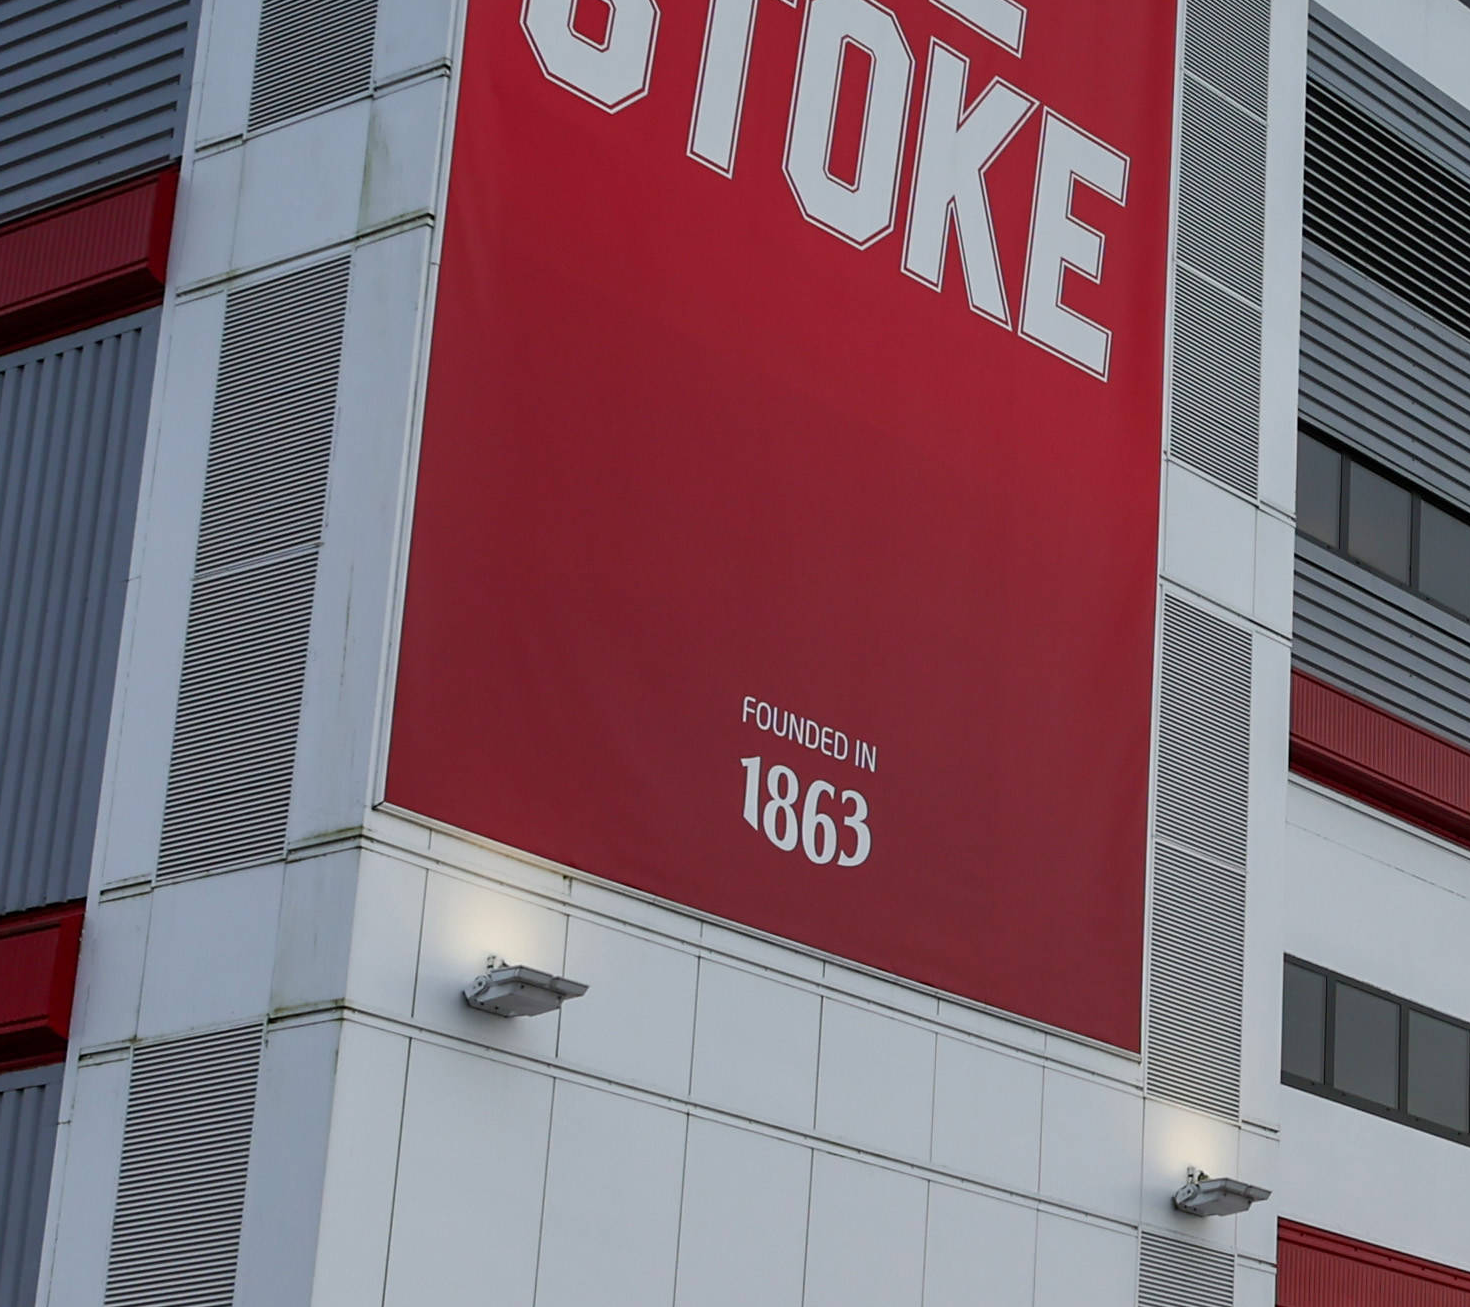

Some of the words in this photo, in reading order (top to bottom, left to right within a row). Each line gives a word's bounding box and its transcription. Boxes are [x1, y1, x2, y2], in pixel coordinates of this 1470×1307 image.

[742, 696, 848, 761] FOUNDED
[855, 740, 877, 773] IN
[740, 756, 872, 867] 1863
